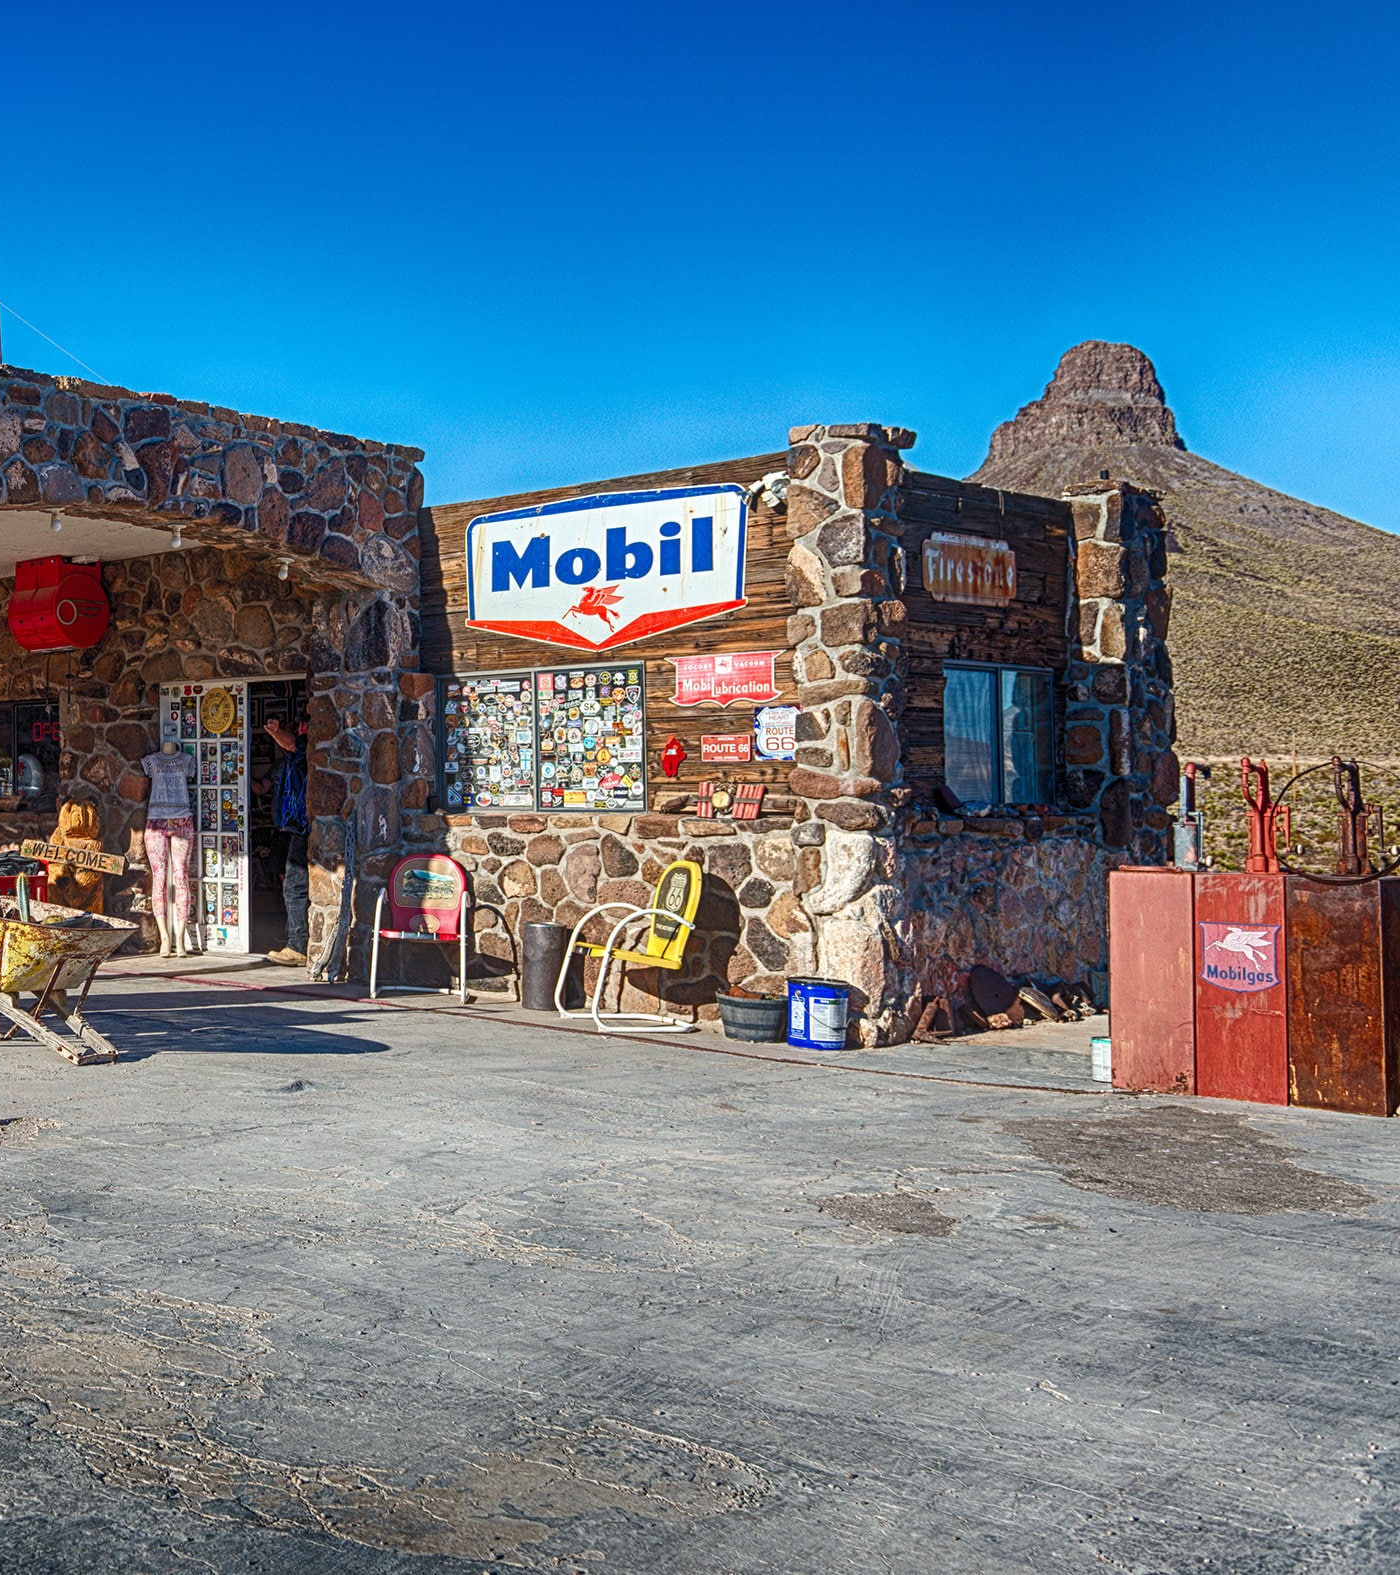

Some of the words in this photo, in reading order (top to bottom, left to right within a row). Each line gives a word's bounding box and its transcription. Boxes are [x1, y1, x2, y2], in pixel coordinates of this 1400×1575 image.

[491, 516, 714, 592] Mobil
[925, 547, 1014, 590] Firestone
[32, 722, 60, 742] OPE
[765, 727, 794, 735] ROUTE
[703, 744, 736, 753] ROUTE
[738, 744, 749, 753] 66
[766, 736, 795, 751] 66
[32, 841, 111, 870] WELCOME
[668, 888, 682, 907] 66
[1206, 964, 1274, 985] Mobilgas
